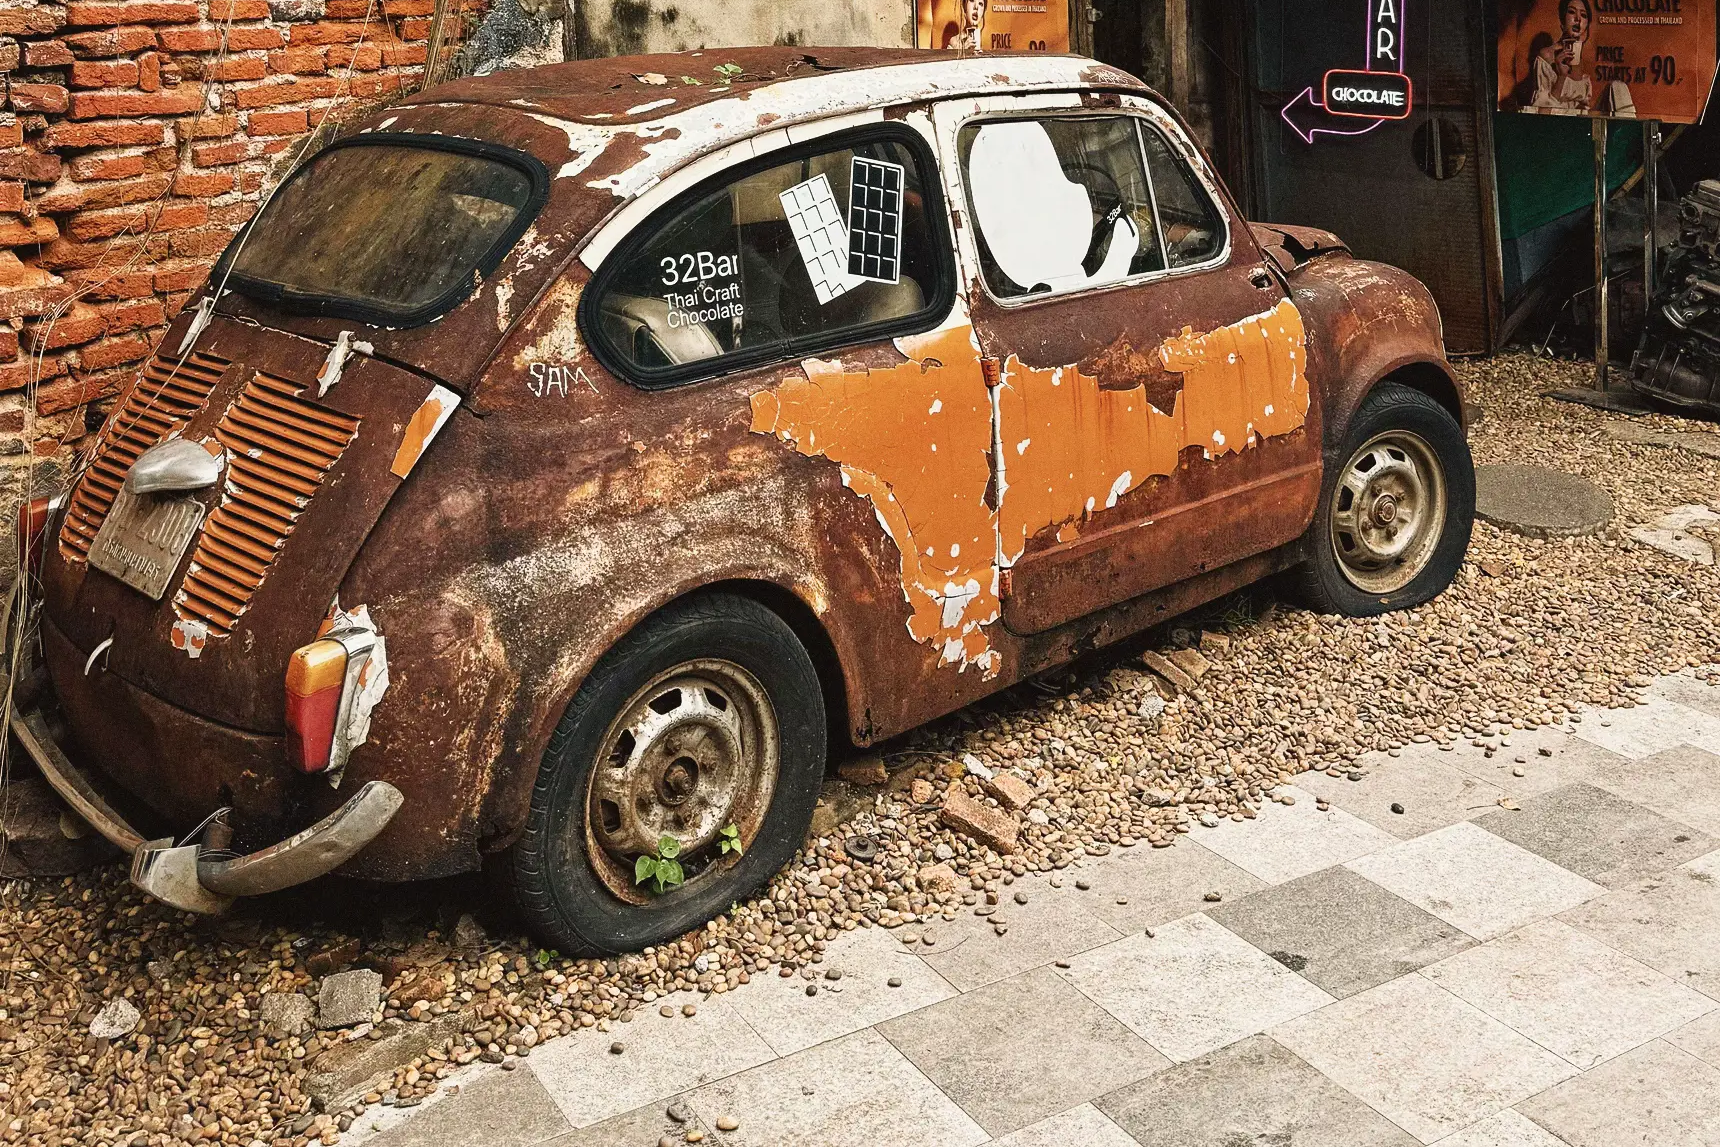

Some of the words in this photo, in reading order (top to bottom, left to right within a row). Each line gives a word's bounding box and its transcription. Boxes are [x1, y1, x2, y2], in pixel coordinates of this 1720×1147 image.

[991, 33, 1012, 49] PRICE
[1596, 47, 1624, 63] PRICE
[1596, 66, 1632, 83] STARTS
[1634, 66, 1647, 83] AT
[1332, 87, 1405, 107] CHOCOLATE
[660, 251, 739, 286] 32Bar
[664, 289, 699, 311] Thai
[703, 282, 741, 305] Craft
[667, 301, 745, 329] Chocolate
[526, 362, 600, 399] SAM
